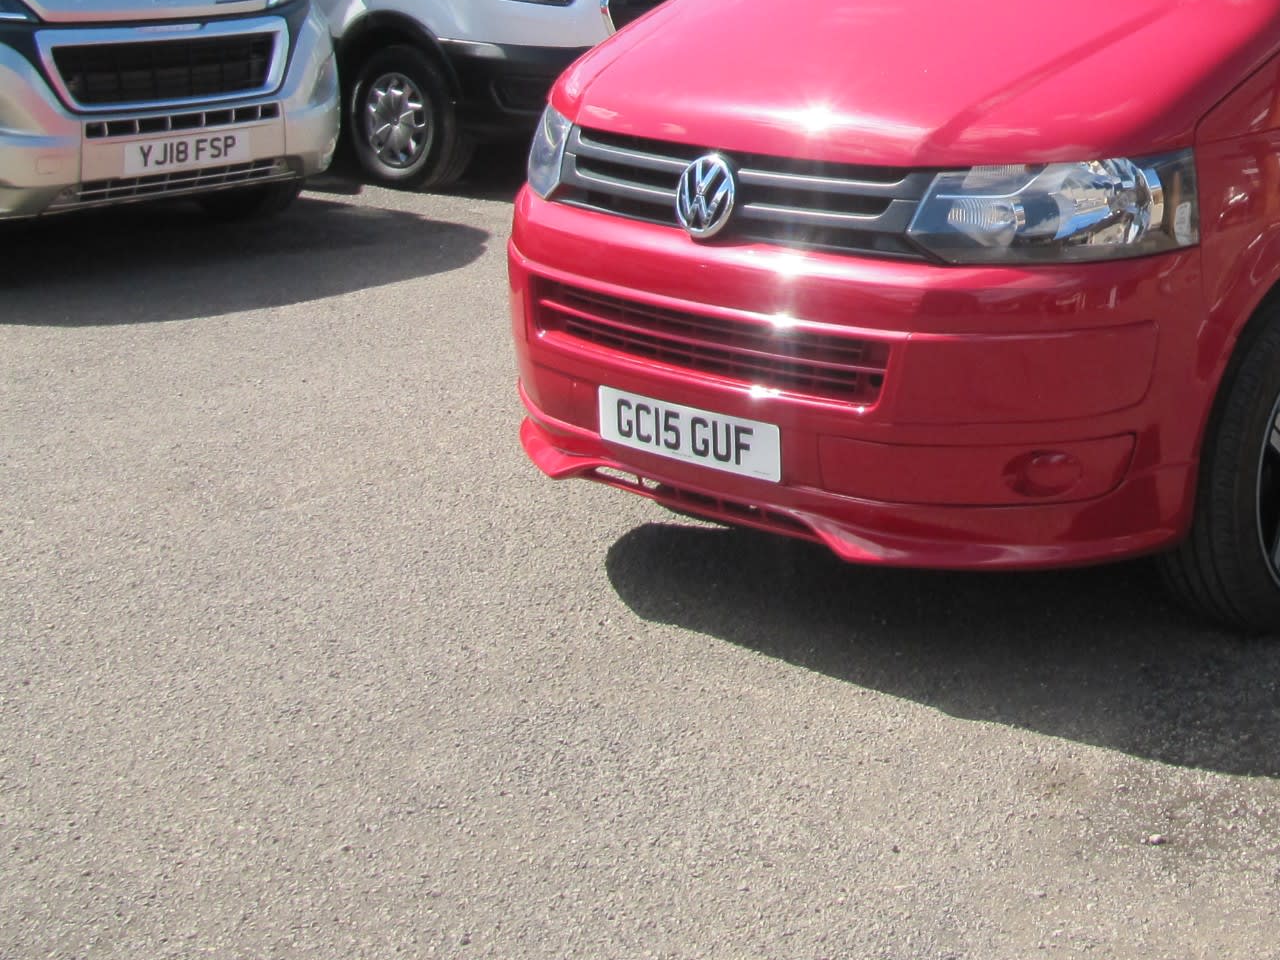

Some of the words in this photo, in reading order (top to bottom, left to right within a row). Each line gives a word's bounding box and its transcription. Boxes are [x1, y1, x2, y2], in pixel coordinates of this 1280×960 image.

[140, 140, 189, 167] YJ18
[195, 135, 236, 161] FSP
[617, 398, 681, 451] GC15
[690, 416, 753, 465] GUF
